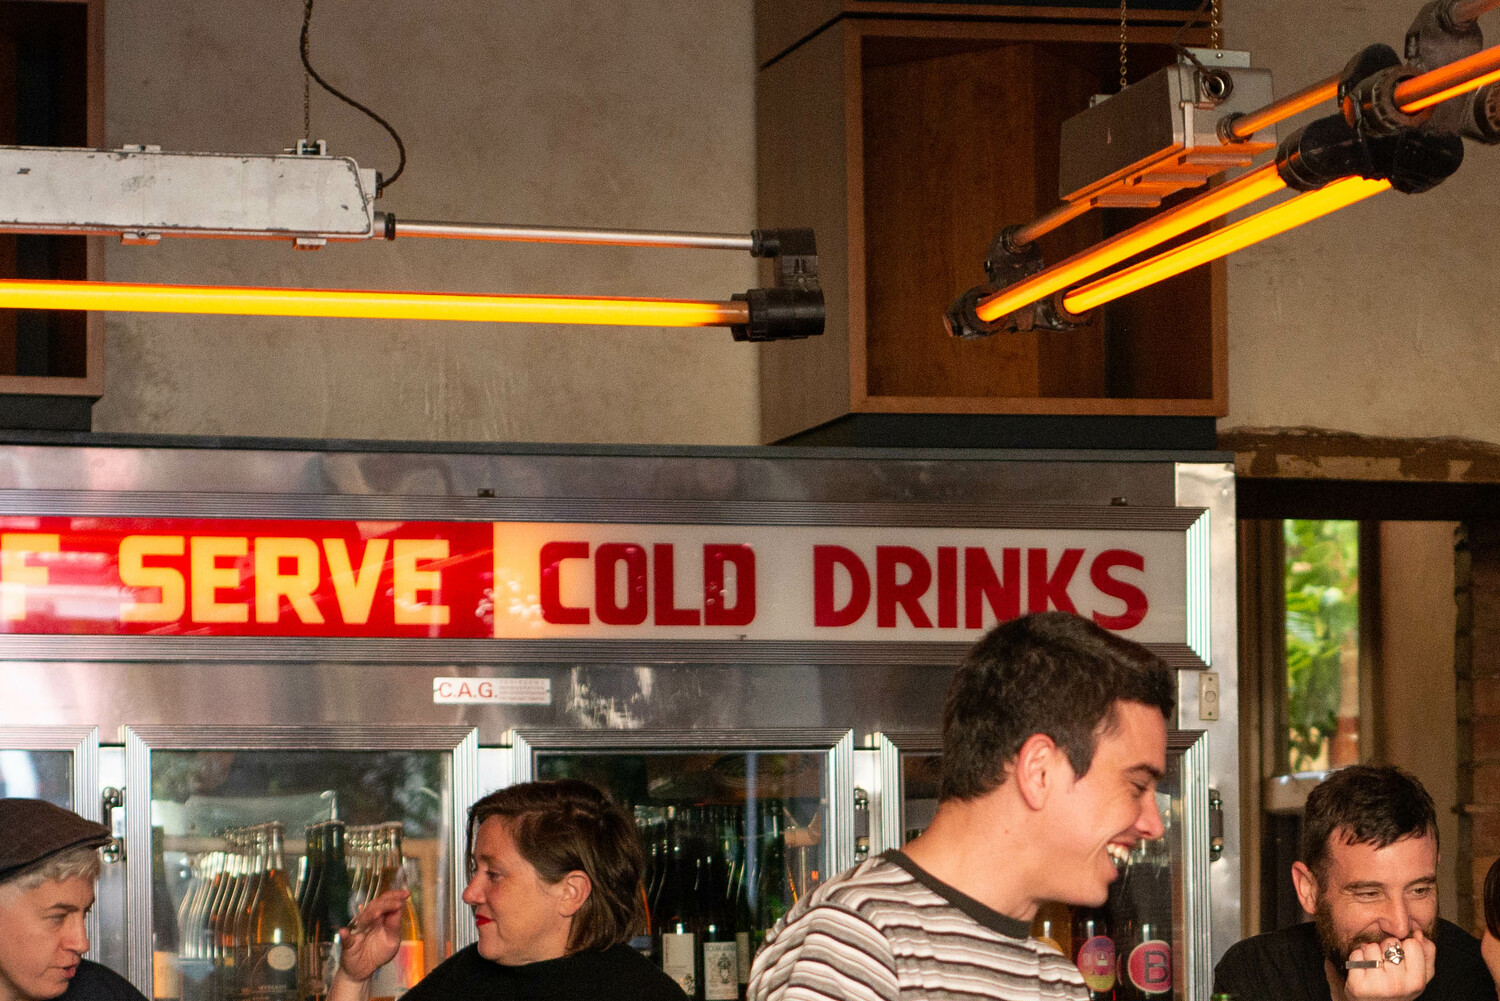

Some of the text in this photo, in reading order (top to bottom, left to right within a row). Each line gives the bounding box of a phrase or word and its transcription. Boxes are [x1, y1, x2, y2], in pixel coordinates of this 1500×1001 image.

[119, 535, 451, 624] SERVE
[540, 541, 756, 627] COLD
[813, 544, 1149, 630] DRINKS
[438, 681, 498, 698] C.A.G.
